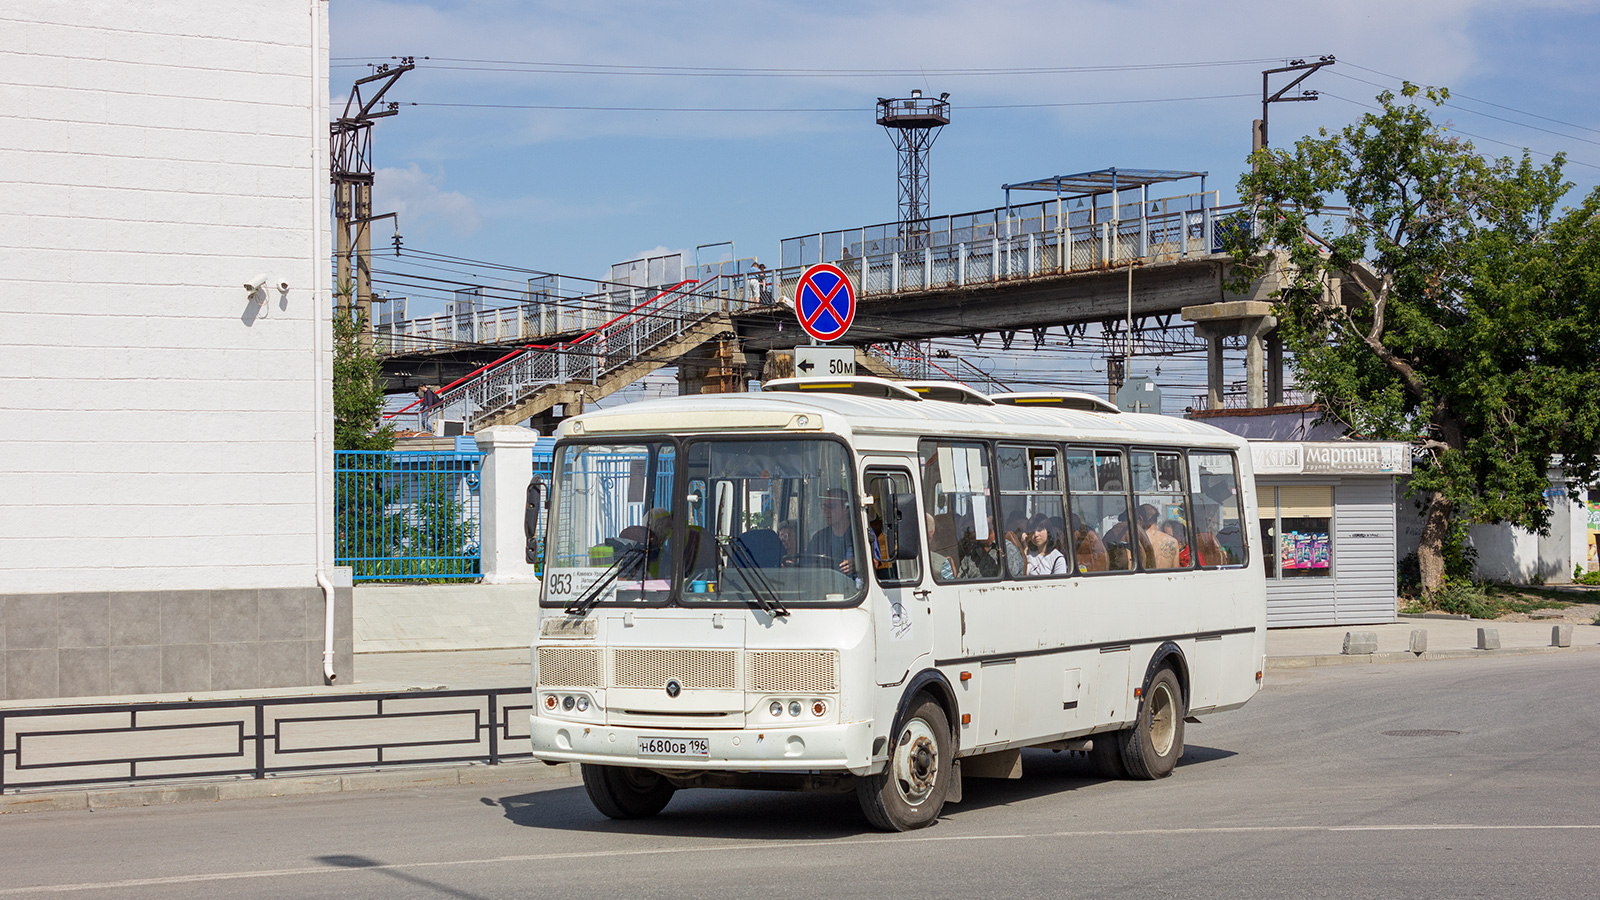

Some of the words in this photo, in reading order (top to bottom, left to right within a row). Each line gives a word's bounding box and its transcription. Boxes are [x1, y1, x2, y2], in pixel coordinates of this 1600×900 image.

[1306, 448, 1379, 468] мартин
[550, 573, 572, 595] 953
[641, 740, 686, 754] Н680ОВ
[688, 740, 707, 751] 196
